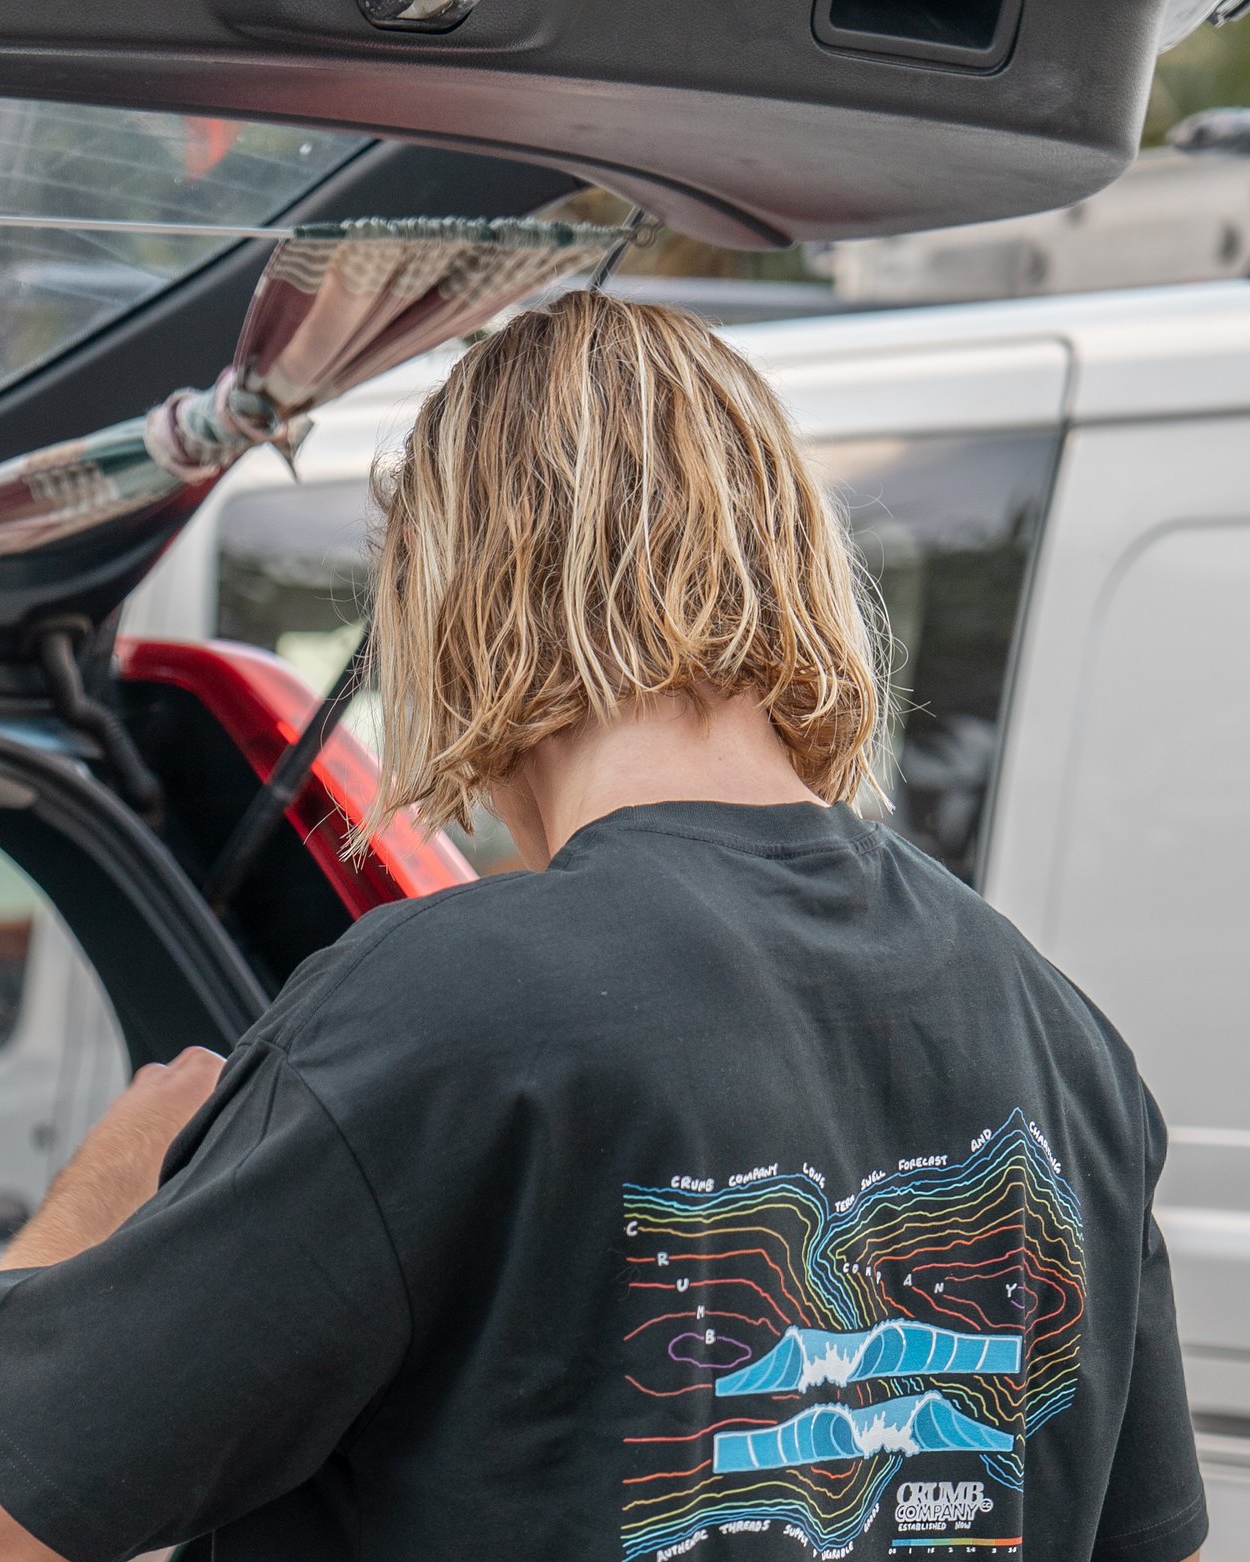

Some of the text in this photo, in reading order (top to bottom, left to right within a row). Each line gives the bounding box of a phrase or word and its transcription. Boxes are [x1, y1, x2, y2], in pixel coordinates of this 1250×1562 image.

[671, 1175, 714, 1192] CRUMB
[729, 1163, 778, 1187] COMPANY
[802, 1162, 826, 1189] LONG
[861, 1170, 886, 1191] SWELL
[898, 1155, 948, 1171] FORECAST
[971, 1128, 992, 1152] AND
[896, 1481, 984, 1506] CRUMB
[895, 1502, 979, 1523] COMPANY
[719, 1519, 771, 1535] THREADS
[783, 1524, 809, 1548] SUPPLY
[898, 1521, 971, 1532] ESTABLISHED NOW
